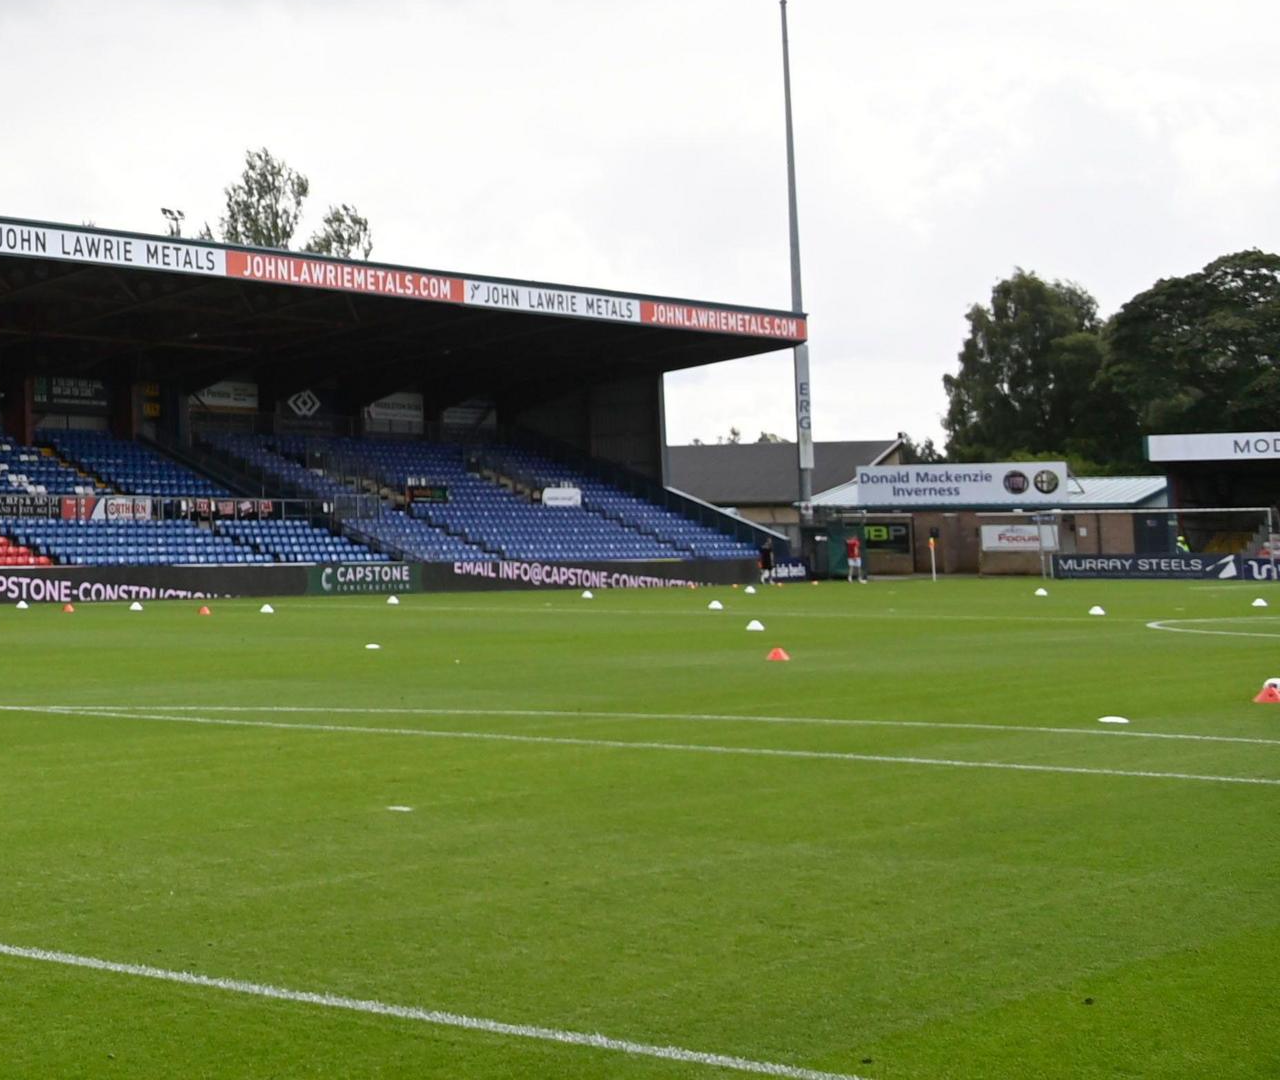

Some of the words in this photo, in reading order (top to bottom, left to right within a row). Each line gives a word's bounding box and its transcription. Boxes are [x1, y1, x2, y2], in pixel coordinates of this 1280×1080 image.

[60, 234, 133, 262] LAWRIE
[146, 243, 215, 271] METALS
[242, 255, 452, 299] JOHNLAWRIEMETALS.COM
[484, 285, 520, 307] JOHN
[527, 290, 578, 313] LAWRIE
[584, 296, 633, 320] METALS
[651, 302, 797, 338] JOHNLAWRIEMETALS.COM
[859, 471, 910, 485] Donald
[915, 469, 993, 484] Mackenzie
[891, 484, 961, 497] Inverness
[336, 565, 410, 582] CAPSTONE
[1059, 558, 1134, 571] MURRAY
[1137, 558, 1202, 571] STEELS
